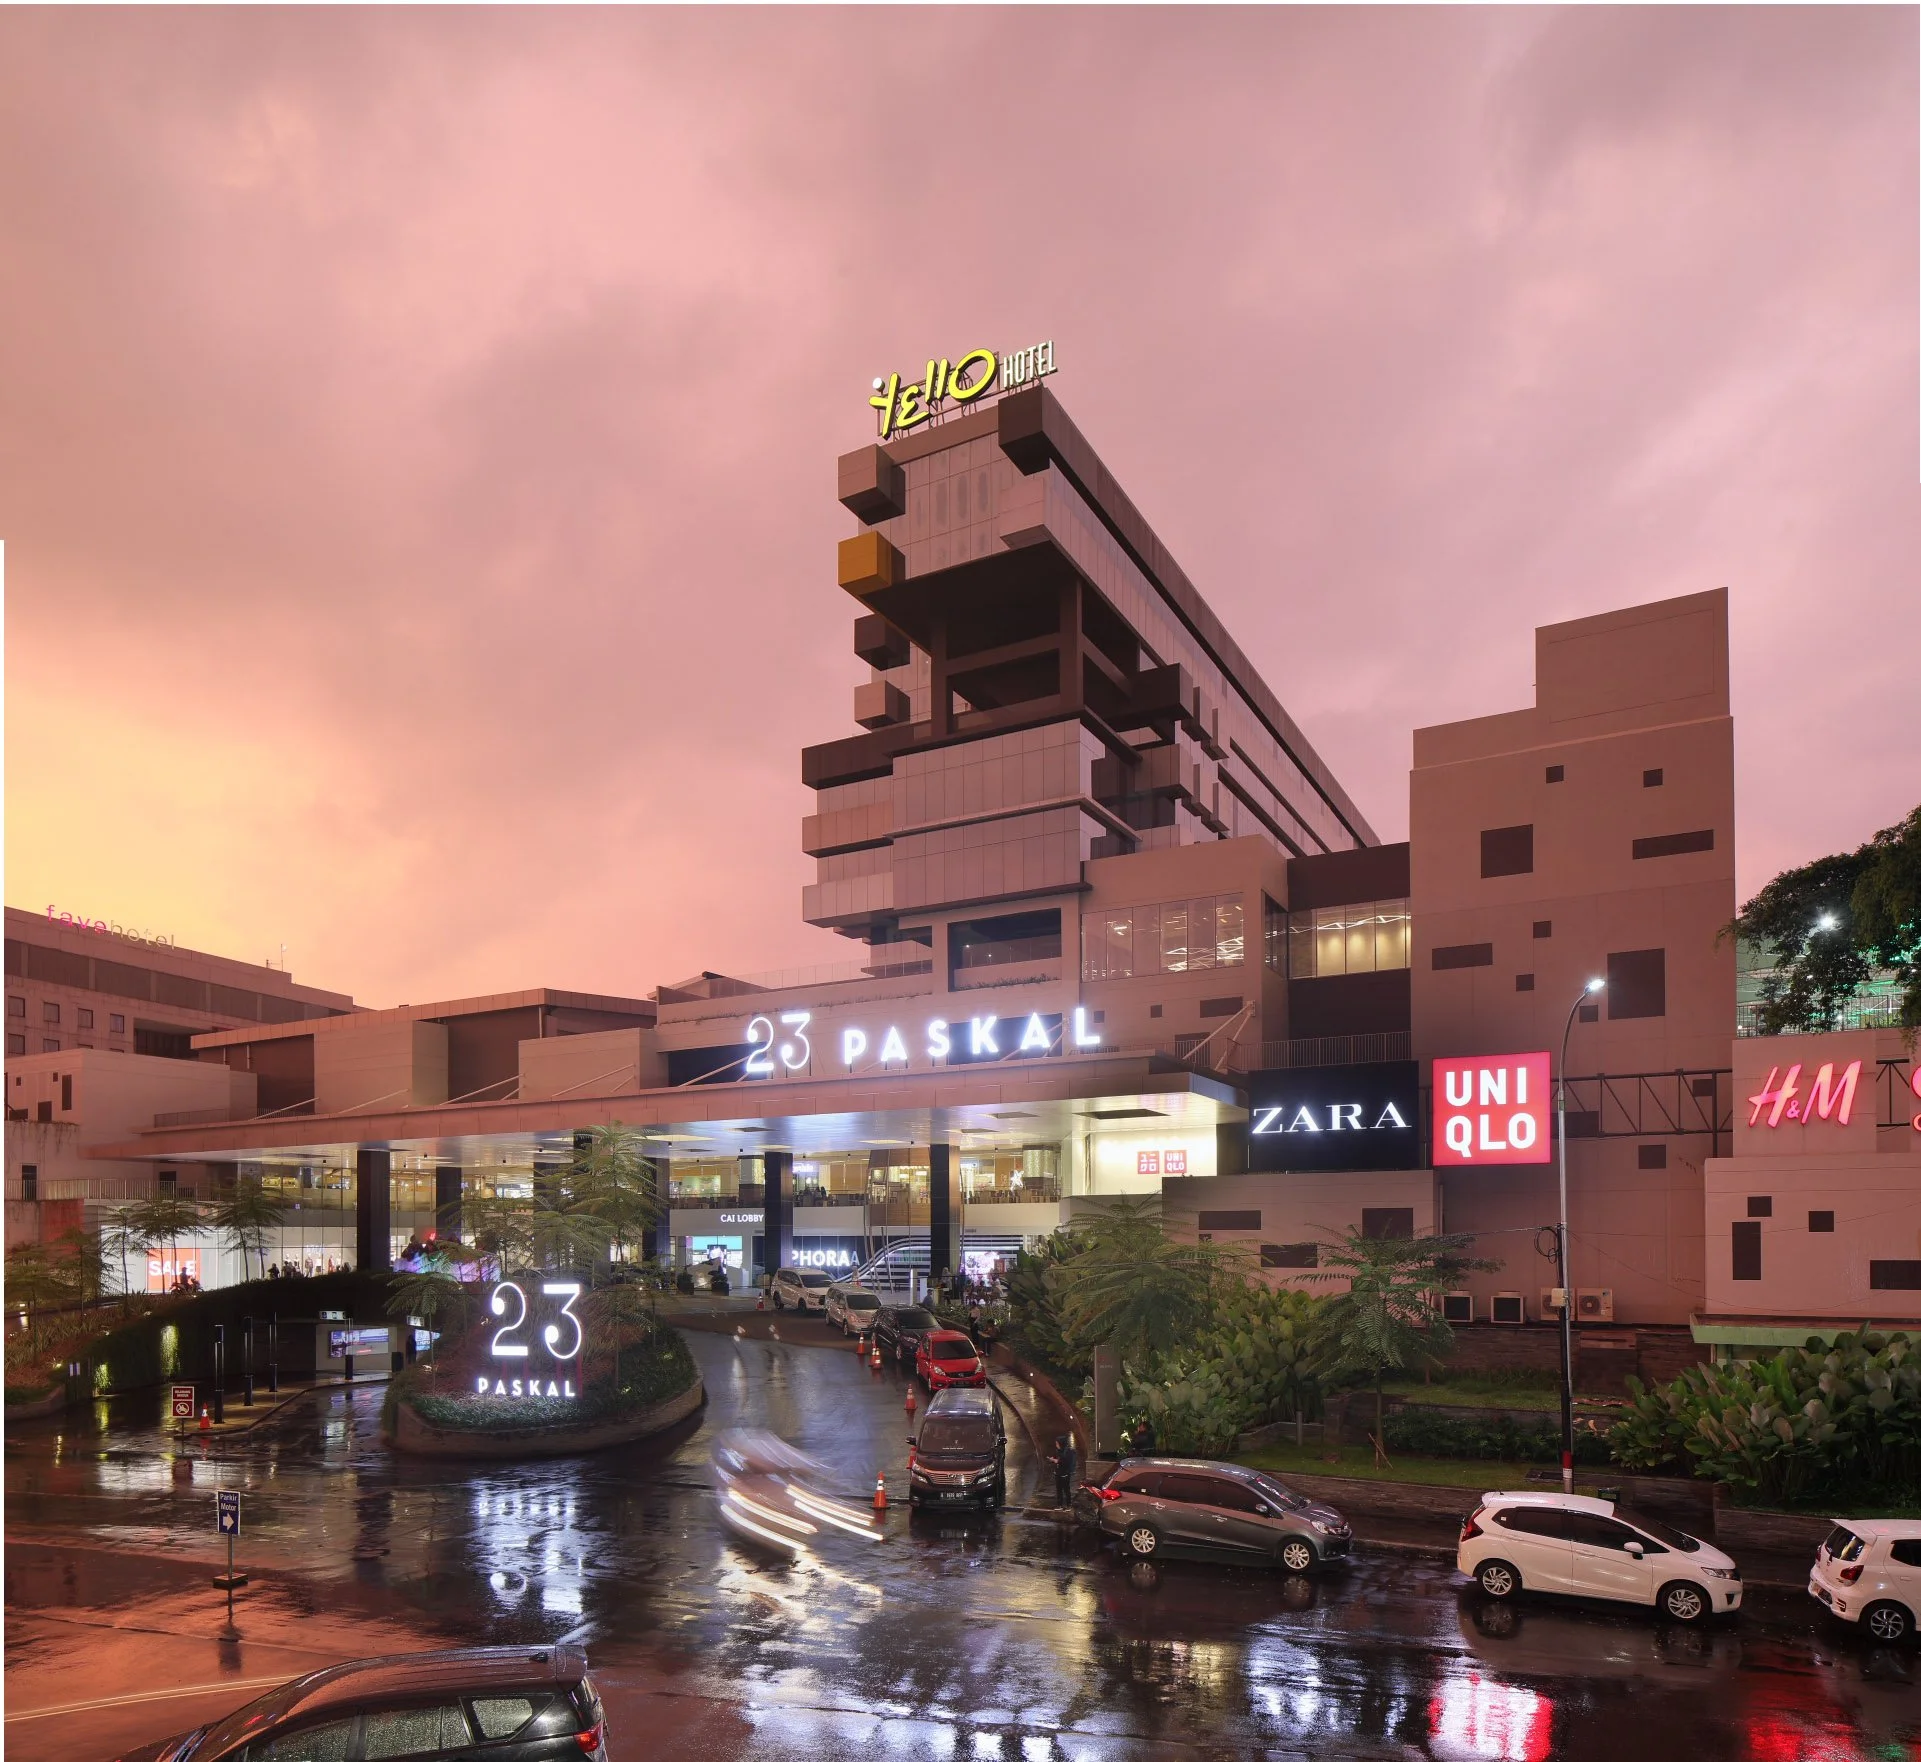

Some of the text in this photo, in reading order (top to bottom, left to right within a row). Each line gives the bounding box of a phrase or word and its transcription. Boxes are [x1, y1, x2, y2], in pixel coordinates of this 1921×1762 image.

[1003, 340, 1058, 388] HOTEL
[746, 1006, 1101, 1073] 23 PASKAL
[1445, 1067, 1527, 1107] UNI
[1748, 1060, 1863, 1128] H&M
[1252, 1101, 1412, 1134] ZARA
[1445, 1112, 1536, 1158] QLO
[1166, 1152, 1183, 1162] UNI
[1166, 1162, 1185, 1172] QLO
[720, 1214, 764, 1223] CAI LOBBY
[149, 1260, 196, 1276] SALE
[492, 1282, 582, 1359] 23
[478, 1378, 576, 1397] PASKAL
[220, 1502, 237, 1511] Motor
